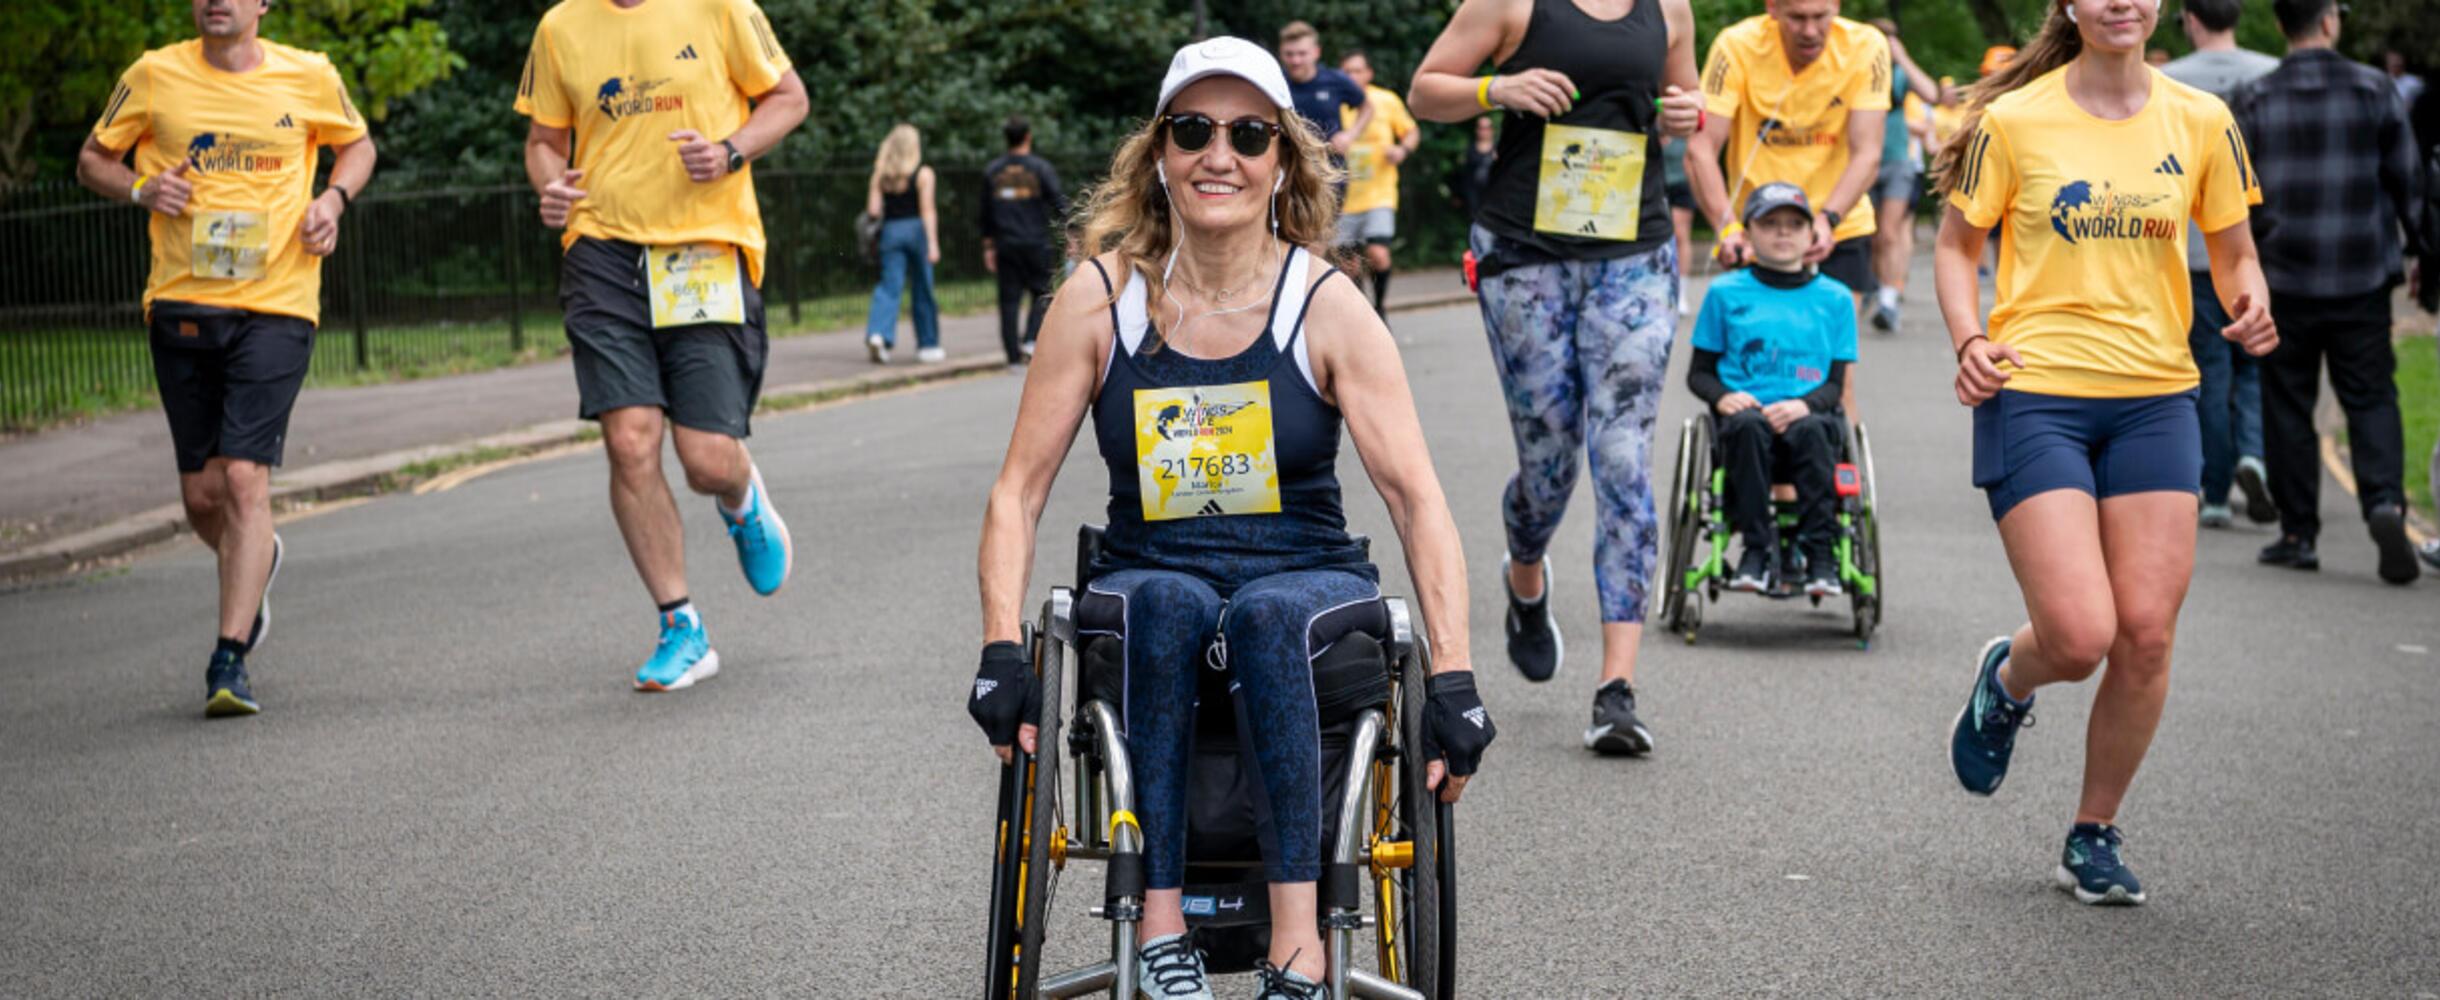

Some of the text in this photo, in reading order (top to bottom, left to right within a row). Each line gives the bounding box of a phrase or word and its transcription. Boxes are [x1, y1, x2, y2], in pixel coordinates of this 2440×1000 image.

[655, 95, 683, 111] RUN
[204, 155, 282, 172] WORLD RUN
[2073, 216, 2176, 240] WORLD RUN
[1161, 453, 1250, 479] 217683
[1219, 896, 1244, 911] 4
